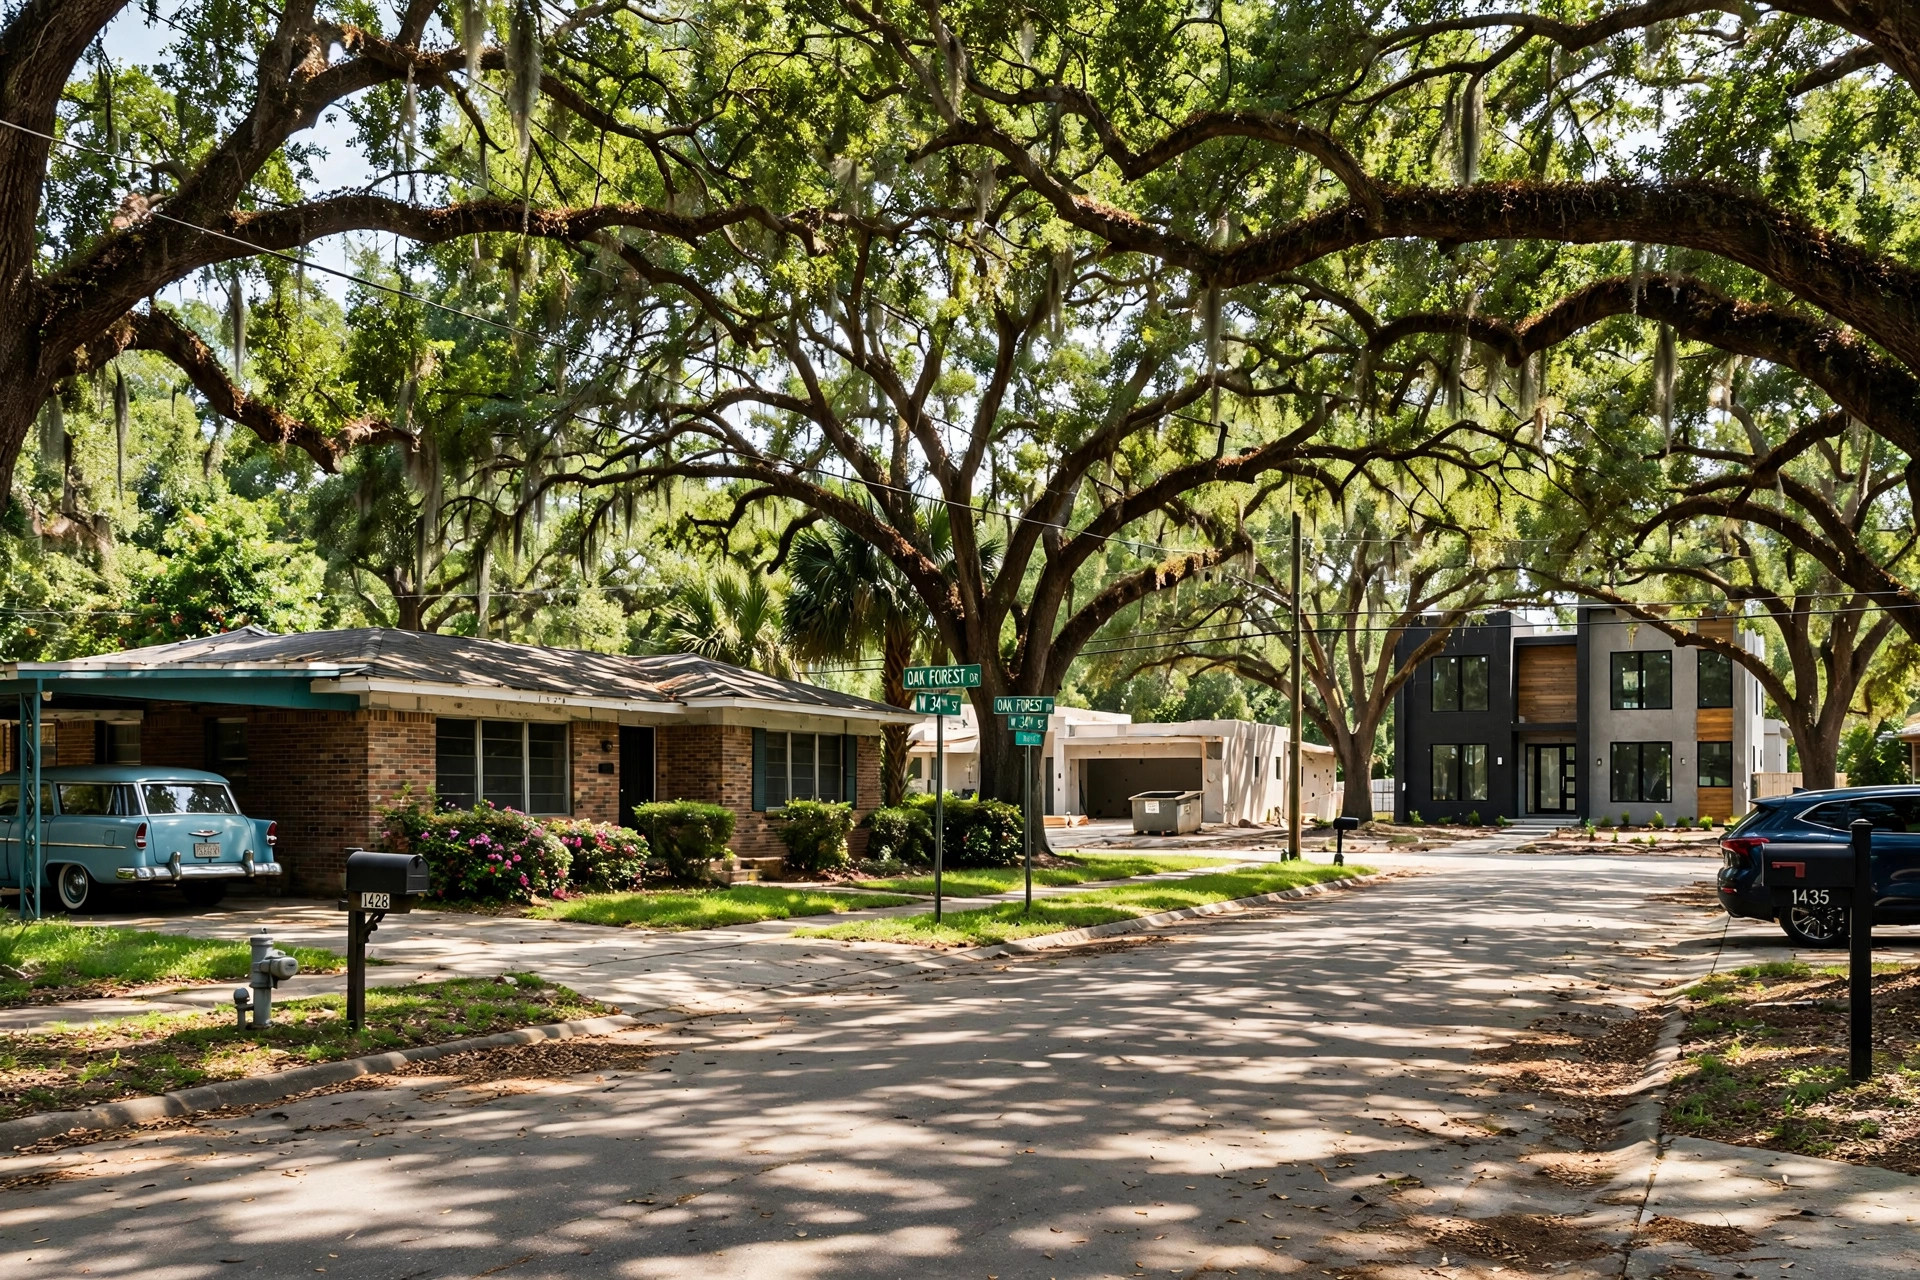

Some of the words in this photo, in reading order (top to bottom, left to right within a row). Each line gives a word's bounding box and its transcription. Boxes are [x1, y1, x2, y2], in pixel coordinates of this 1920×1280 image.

[907, 670, 925, 686] OAK
[929, 668, 966, 686] FOREST
[969, 672, 979, 684] DR
[918, 694, 927, 712] W
[997, 699, 1013, 712] OAK
[1016, 699, 1043, 712] FOREST
[363, 893, 389, 908] 1428
[1791, 888, 1830, 905] 1435
